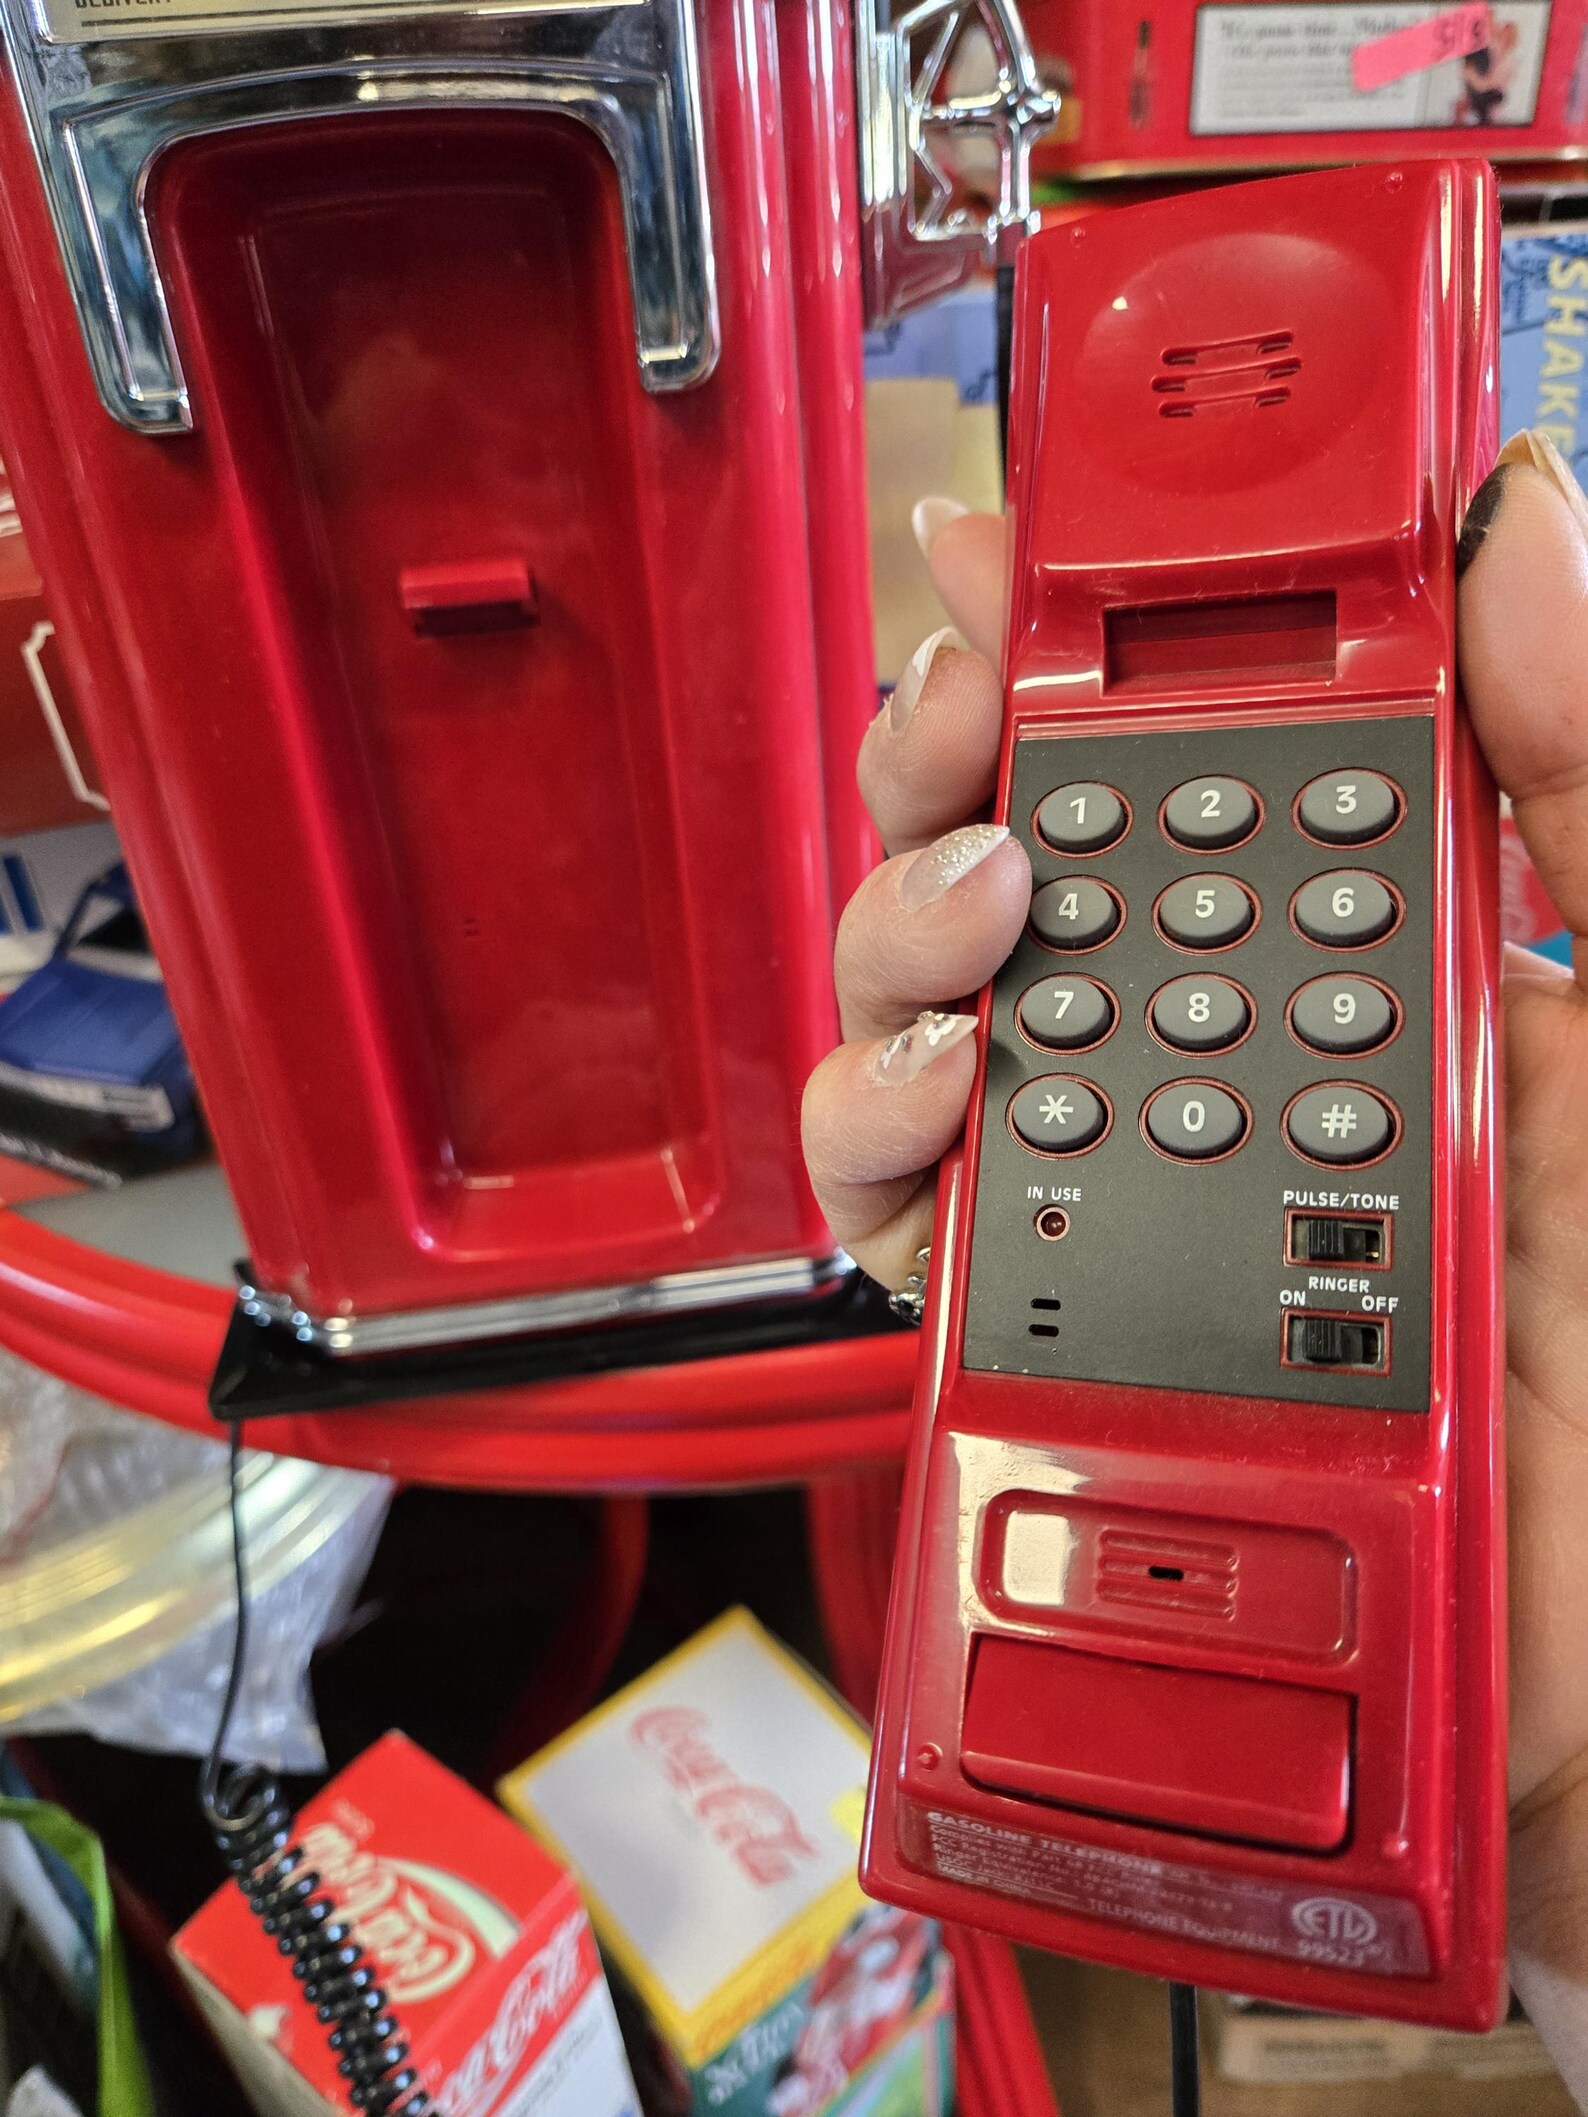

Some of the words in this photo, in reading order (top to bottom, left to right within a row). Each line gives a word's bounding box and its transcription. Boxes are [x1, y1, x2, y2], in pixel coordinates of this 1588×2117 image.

[1068, 797, 1087, 825] 1
[1199, 789, 1221, 818] 2
[1334, 784, 1358, 815] 3
[1057, 892, 1079, 921] 4
[1194, 889, 1216, 919] 5
[1331, 887, 1355, 918] 6
[1052, 990, 1075, 1020] 7
[1187, 991, 1210, 1023] 8
[1332, 993, 1356, 1025] 9
[1182, 1101, 1206, 1133] 0
[1320, 1103, 1358, 1139] #
[1026, 1185, 1044, 1200] IN
[1050, 1186, 1082, 1201] USE
[1282, 1190, 1400, 1210] PULSE/TONE
[1279, 1290, 1307, 1306] ON
[1308, 1275, 1371, 1294] RINGER
[1361, 1295, 1399, 1313] OFF
[926, 1809, 1032, 1846] GASOLINE
